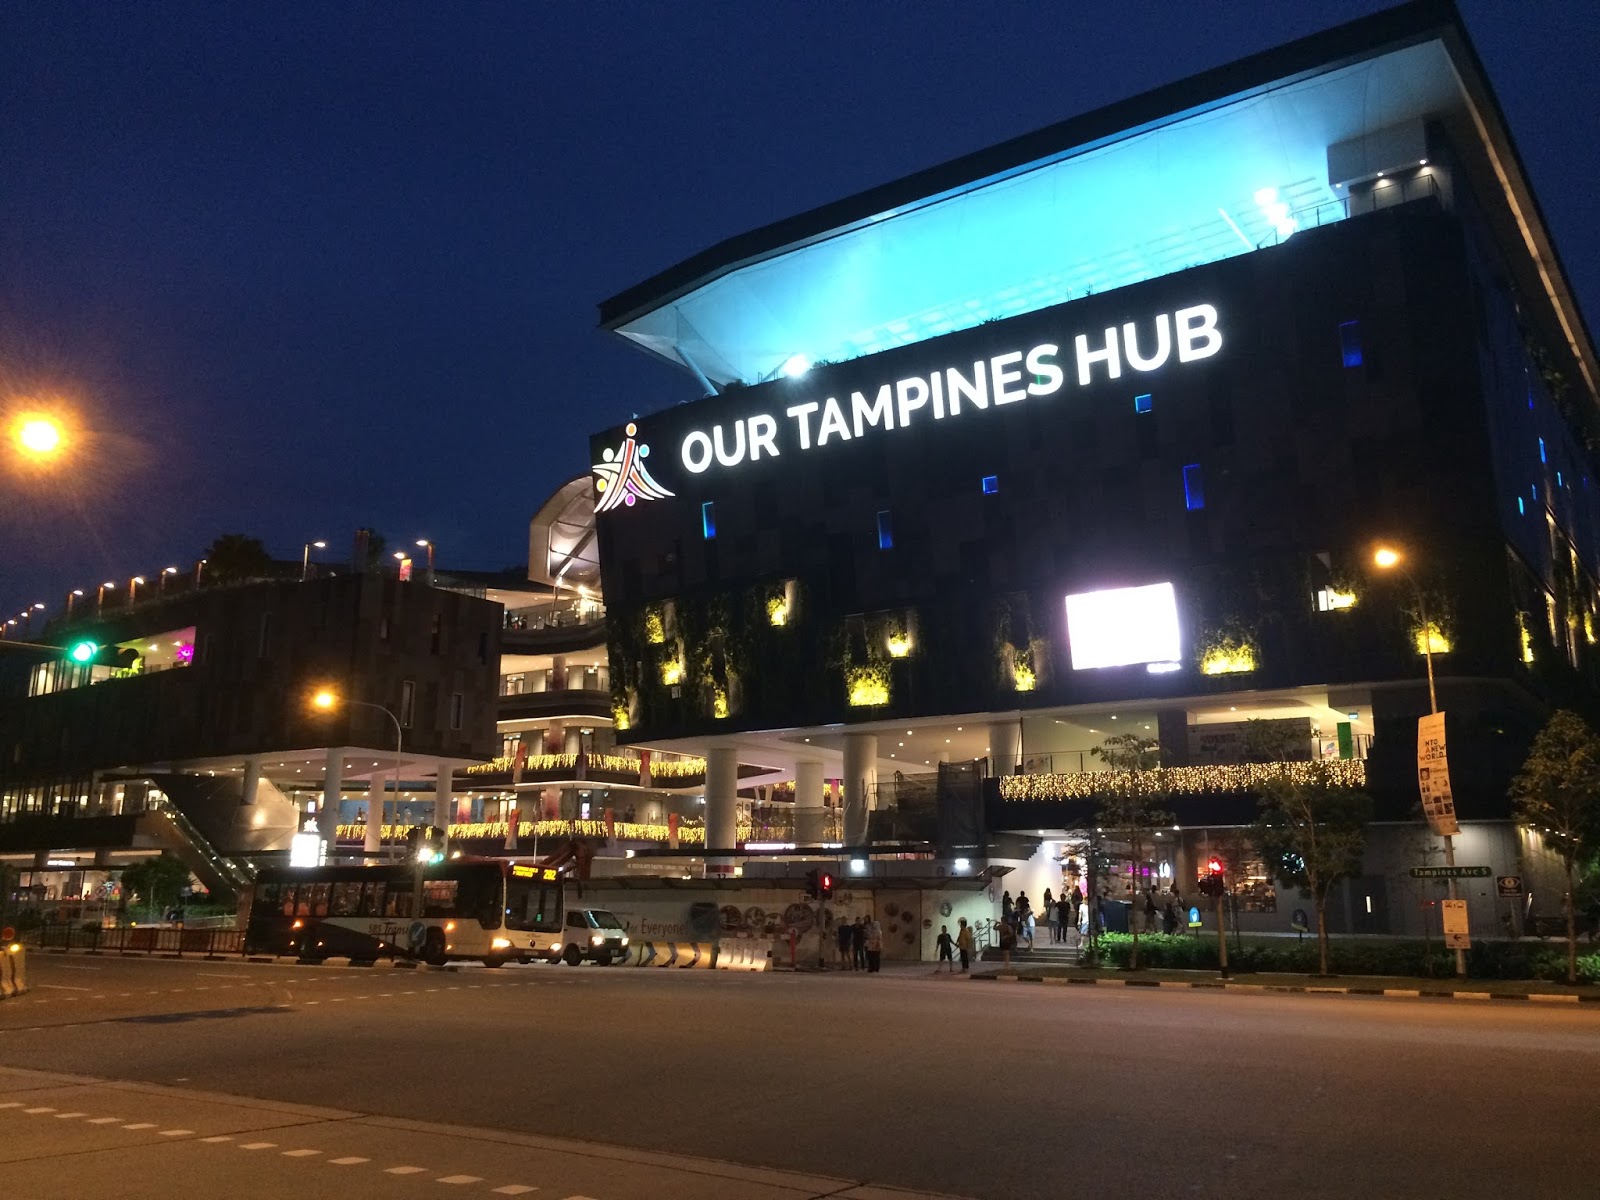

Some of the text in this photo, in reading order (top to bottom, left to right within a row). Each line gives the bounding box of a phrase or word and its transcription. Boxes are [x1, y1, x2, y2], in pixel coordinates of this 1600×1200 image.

[680, 303, 1223, 474] OUR TAMPINES HUB
[1414, 868, 1457, 878] Tampines
[1461, 868, 1478, 876] Ave
